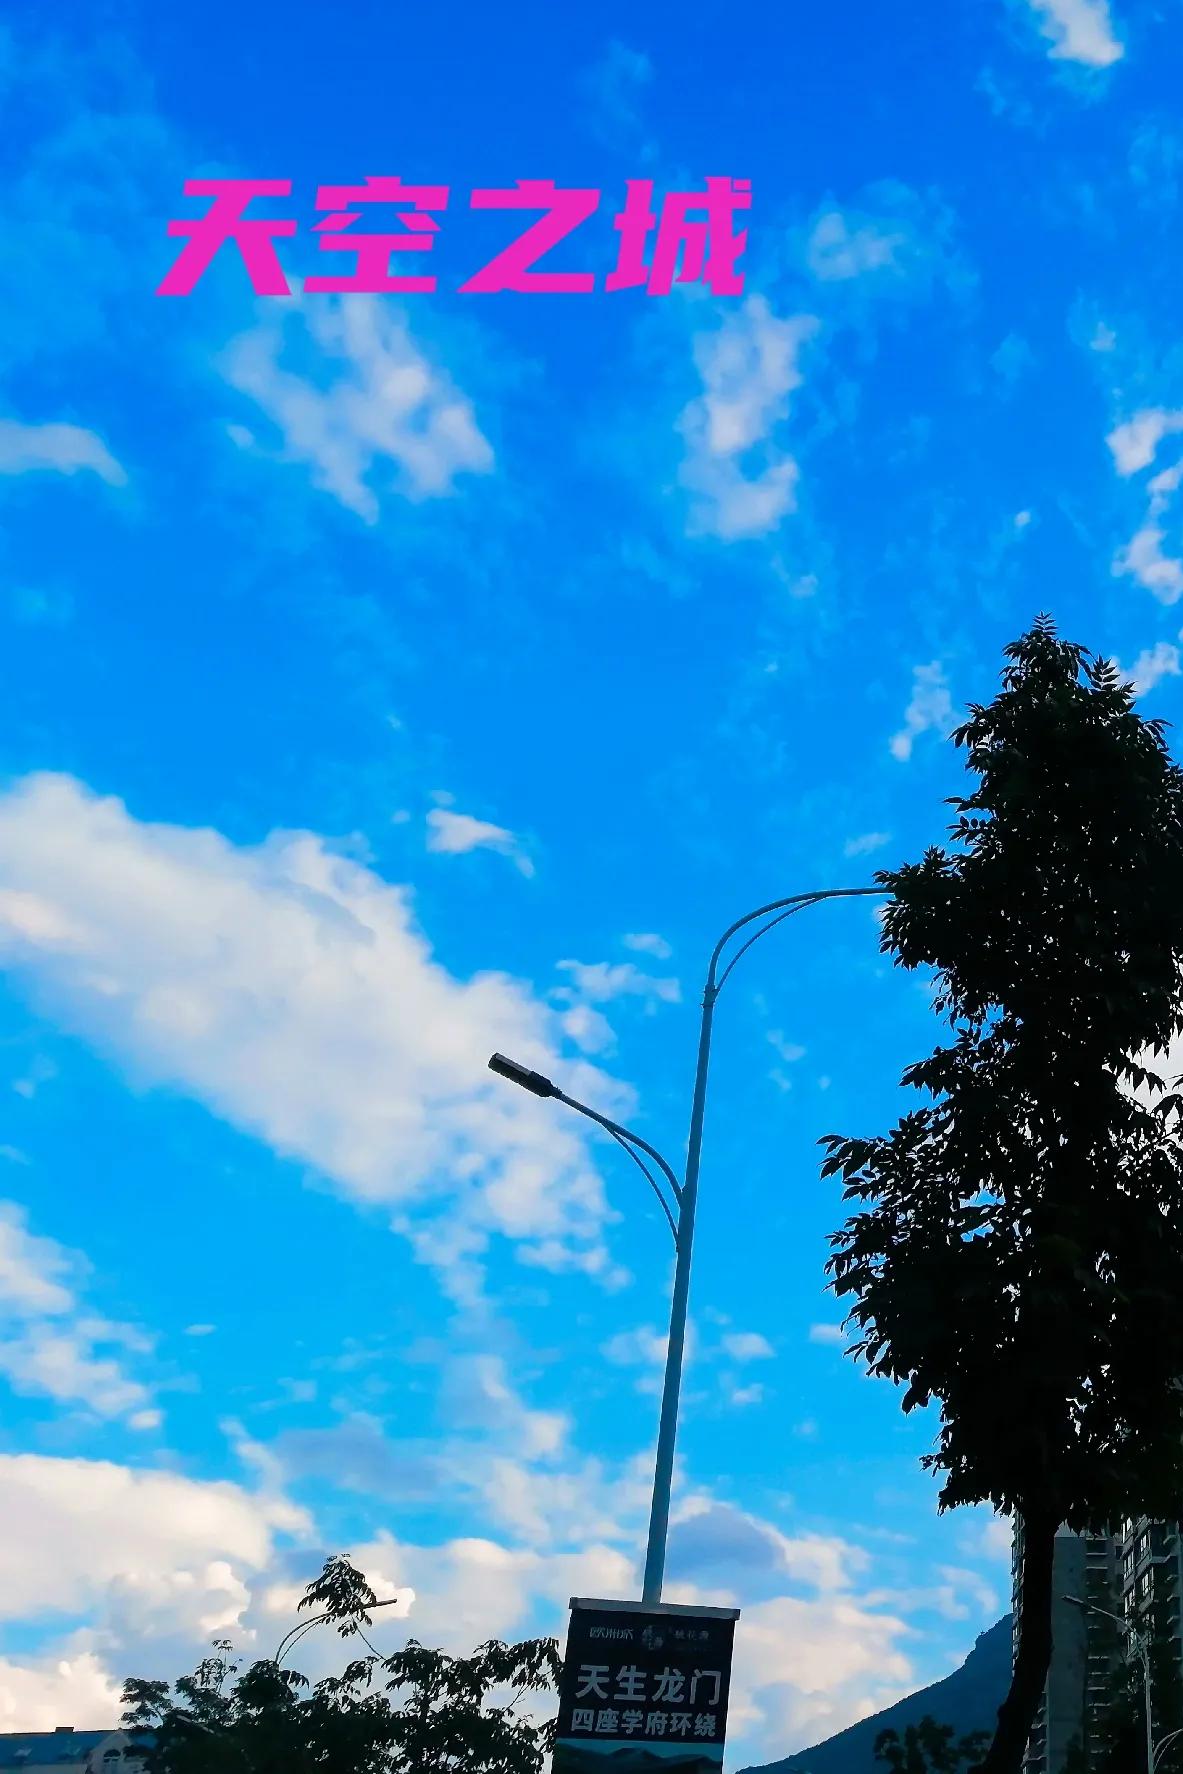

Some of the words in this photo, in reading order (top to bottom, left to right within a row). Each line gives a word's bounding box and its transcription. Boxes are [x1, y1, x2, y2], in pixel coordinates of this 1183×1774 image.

[575, 1664, 722, 1706] 天生龙门
[570, 1707, 718, 1738] 四座学府环绕
